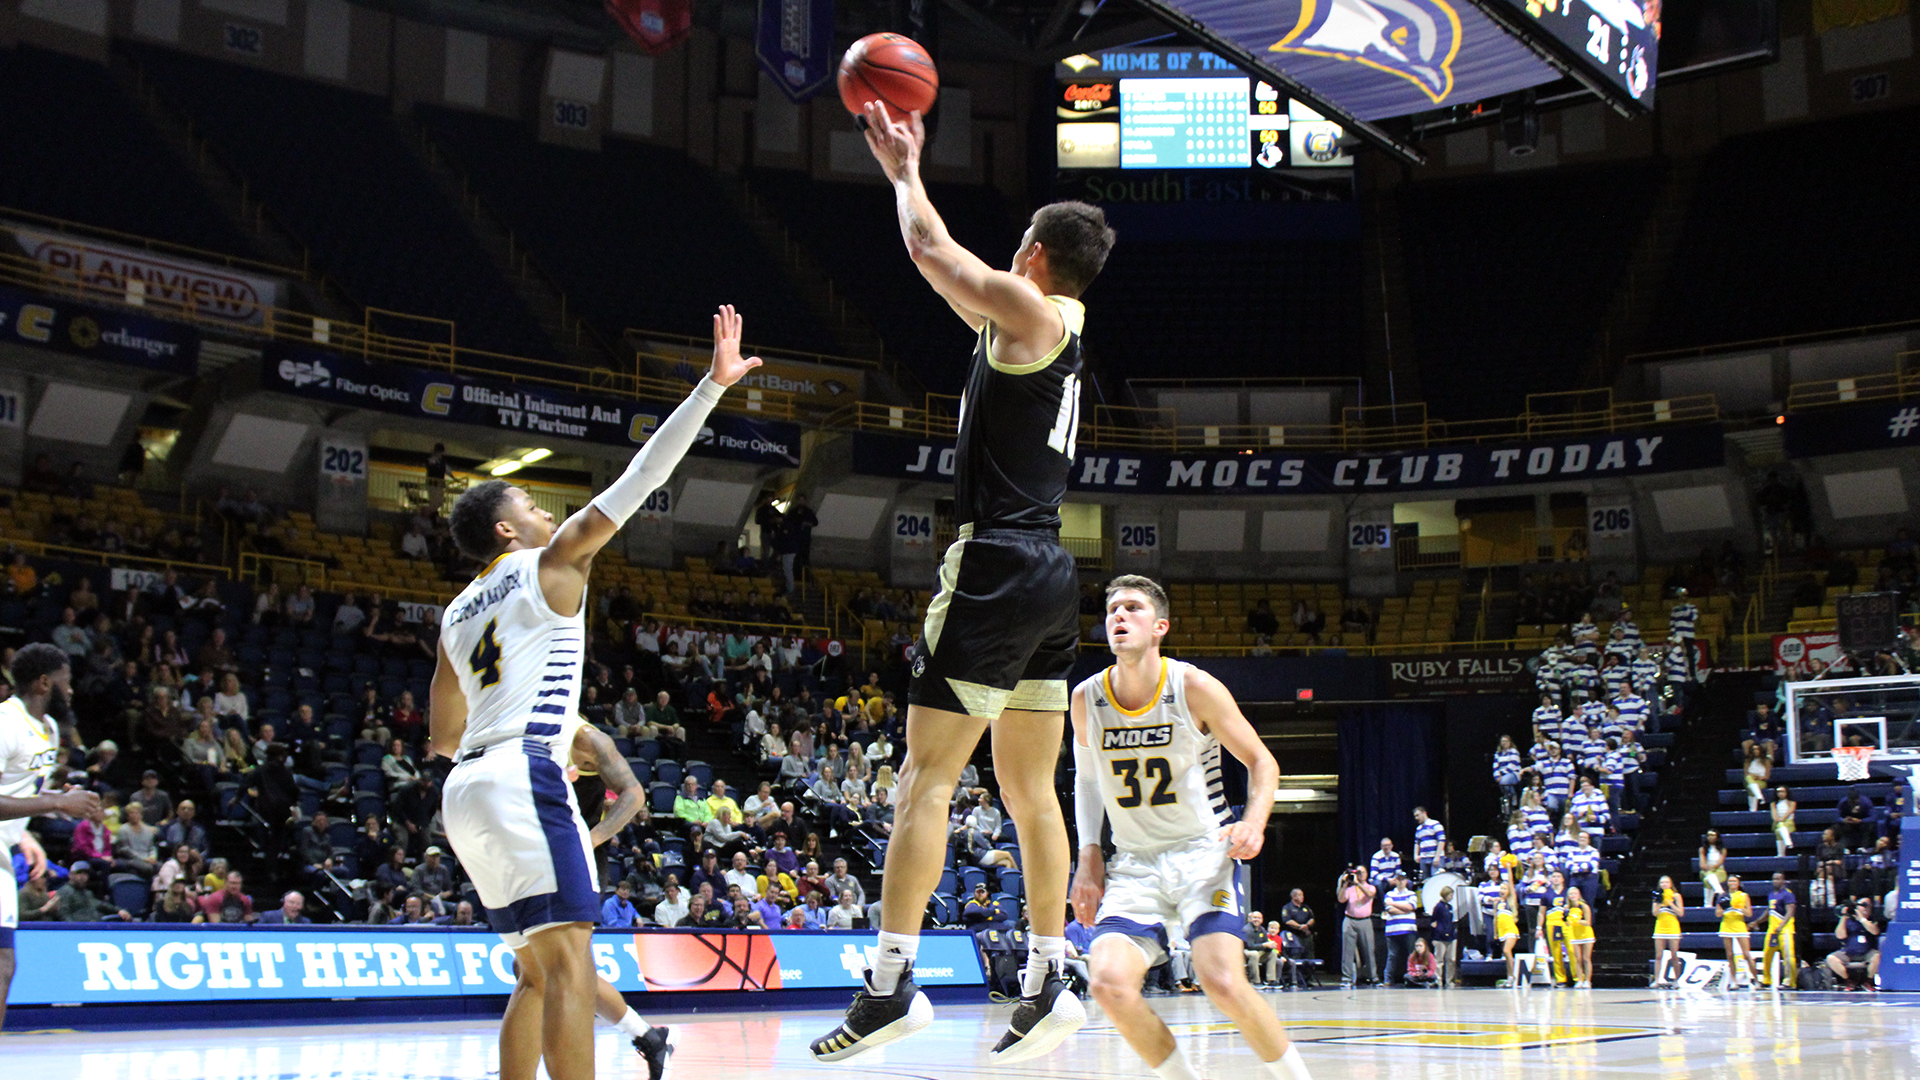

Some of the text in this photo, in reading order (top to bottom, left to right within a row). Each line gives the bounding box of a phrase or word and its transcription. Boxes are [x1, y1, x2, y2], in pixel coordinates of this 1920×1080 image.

[226, 25, 259, 53] 302
[1101, 53, 1160, 71] HOME
[1167, 52, 1192, 70] OF
[556, 101, 587, 127] 303
[49, 250, 247, 312] PLAINVIEW
[101, 327, 180, 359] erlanger
[336, 377, 410, 402] Fiber Optics
[462, 385, 621, 424] Official Internet And
[498, 408, 587, 437] TV Partner
[719, 434, 748, 450] Fiber
[751, 438, 788, 456] Optics
[323, 446, 363, 475] 202
[1070, 455, 1141, 486] HE
[1166, 459, 1304, 487] MOCS
[1333, 453, 1464, 486] CLUB
[1489, 436, 1663, 478] TODAY
[640, 488, 669, 512] 03
[897, 515, 930, 537] 204
[1593, 508, 1631, 531] 206
[1121, 526, 1156, 547] 205
[1352, 524, 1387, 545] 205
[469, 614, 504, 691] 4
[1391, 658, 1523, 683] RUBY FALLS
[1104, 727, 1171, 748] MOCS
[1110, 756, 1178, 809] 32
[78, 942, 285, 990] RIGHT
[296, 943, 450, 987] HERE
[455, 943, 517, 985] FO
[912, 967, 964, 978] ennessee
